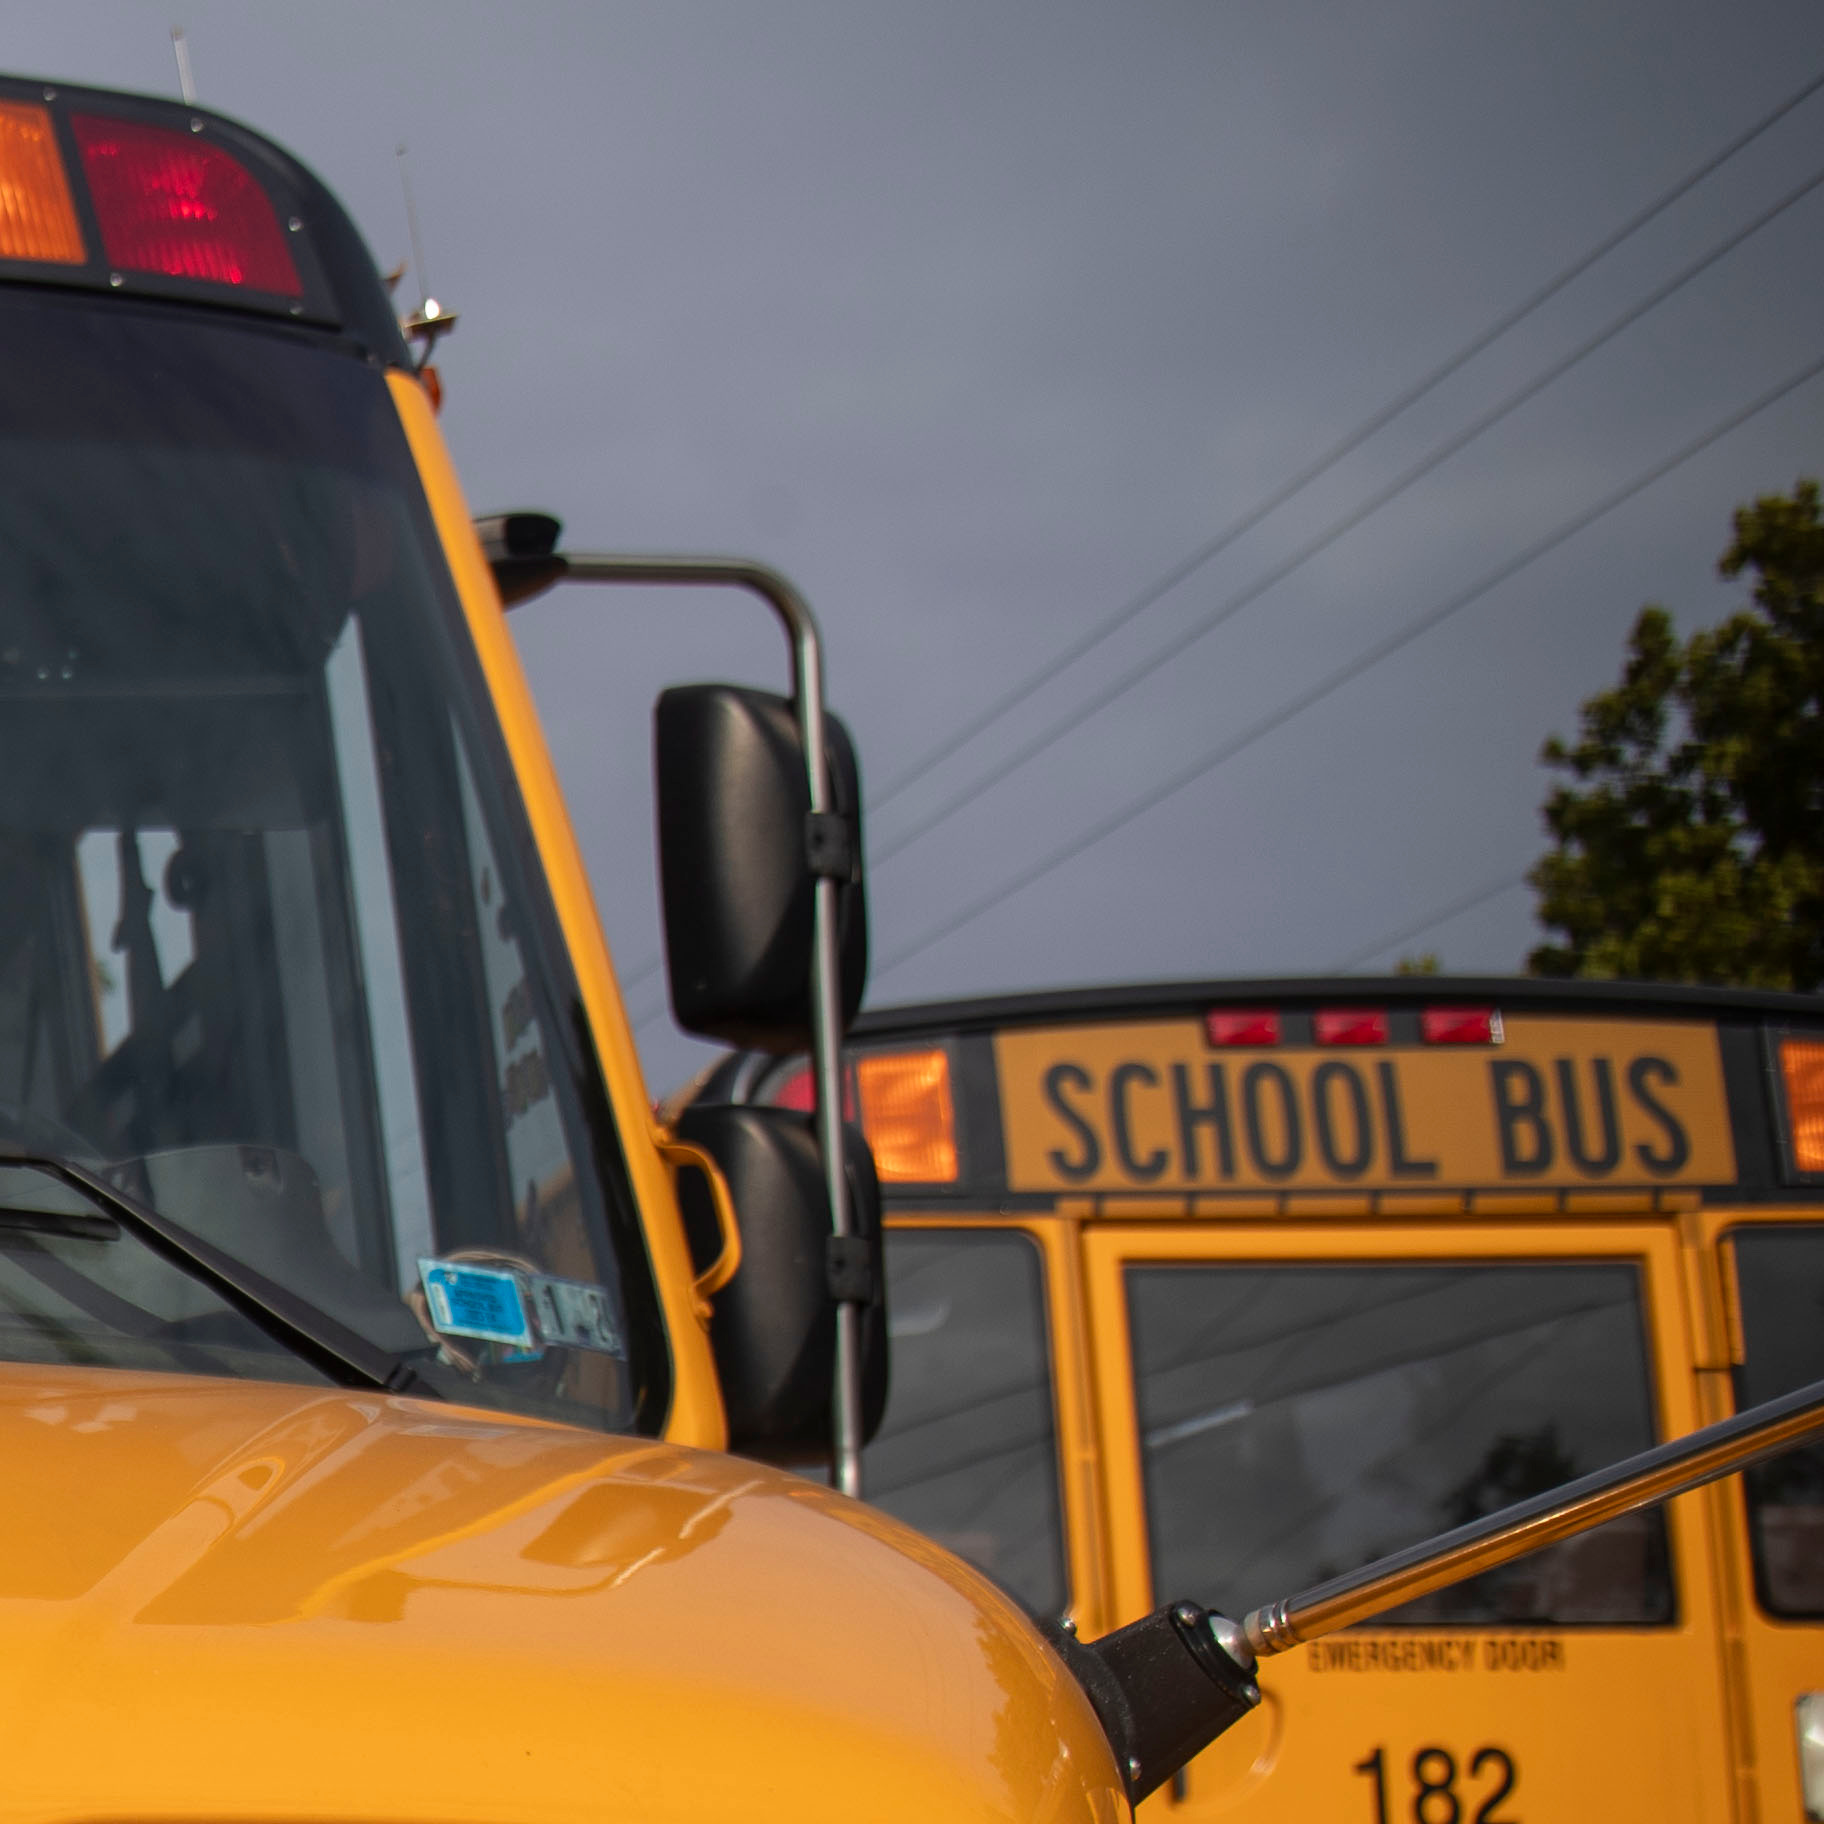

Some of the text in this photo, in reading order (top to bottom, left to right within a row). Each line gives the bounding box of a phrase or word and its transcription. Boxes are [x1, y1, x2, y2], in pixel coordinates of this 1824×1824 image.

[1042, 1055, 1691, 1184] SCHOOL BUS
[1307, 1638, 1566, 1673] EMERGENCY DOOR
